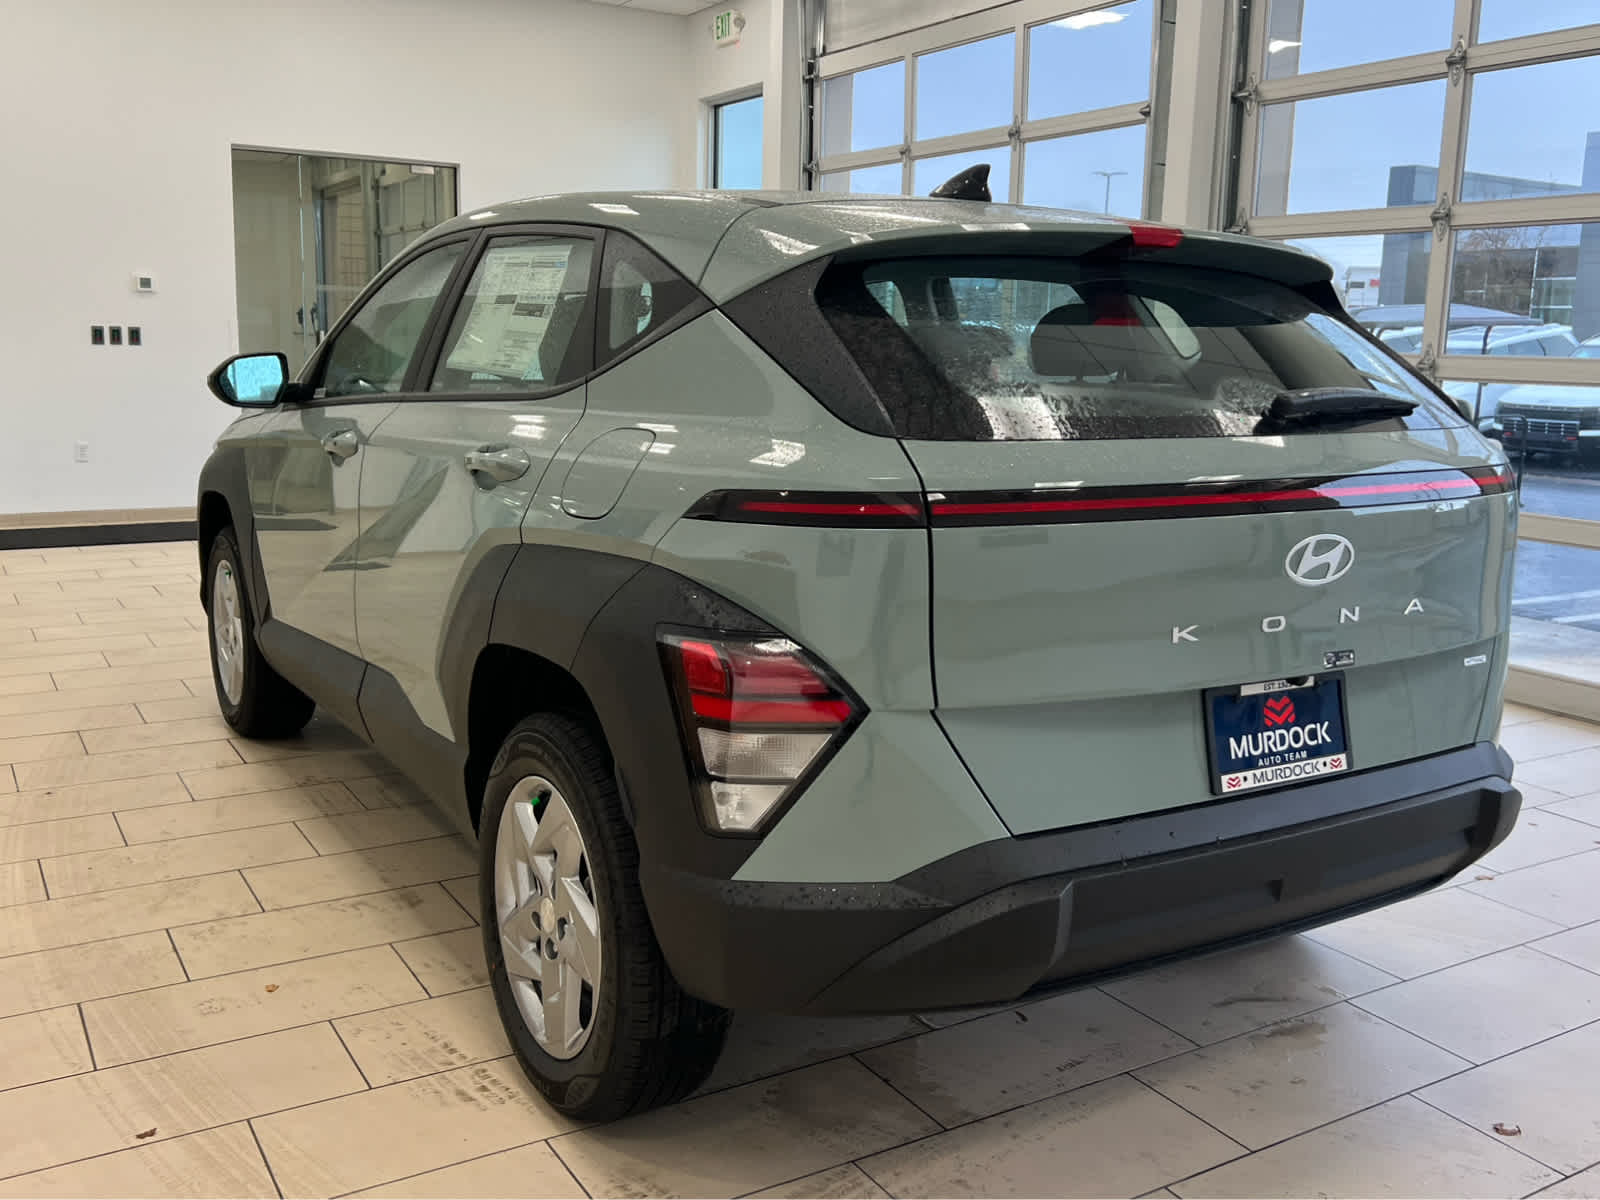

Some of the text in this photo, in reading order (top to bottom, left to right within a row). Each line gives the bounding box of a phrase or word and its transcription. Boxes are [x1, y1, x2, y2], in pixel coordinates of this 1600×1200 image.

[716, 12, 731, 40] EXIT
[1172, 598, 1424, 643] KONA
[1229, 721, 1332, 759] MURDOCK
[1252, 761, 1320, 784] MURDOCK
[1258, 751, 1308, 766] AUTO TEAM
